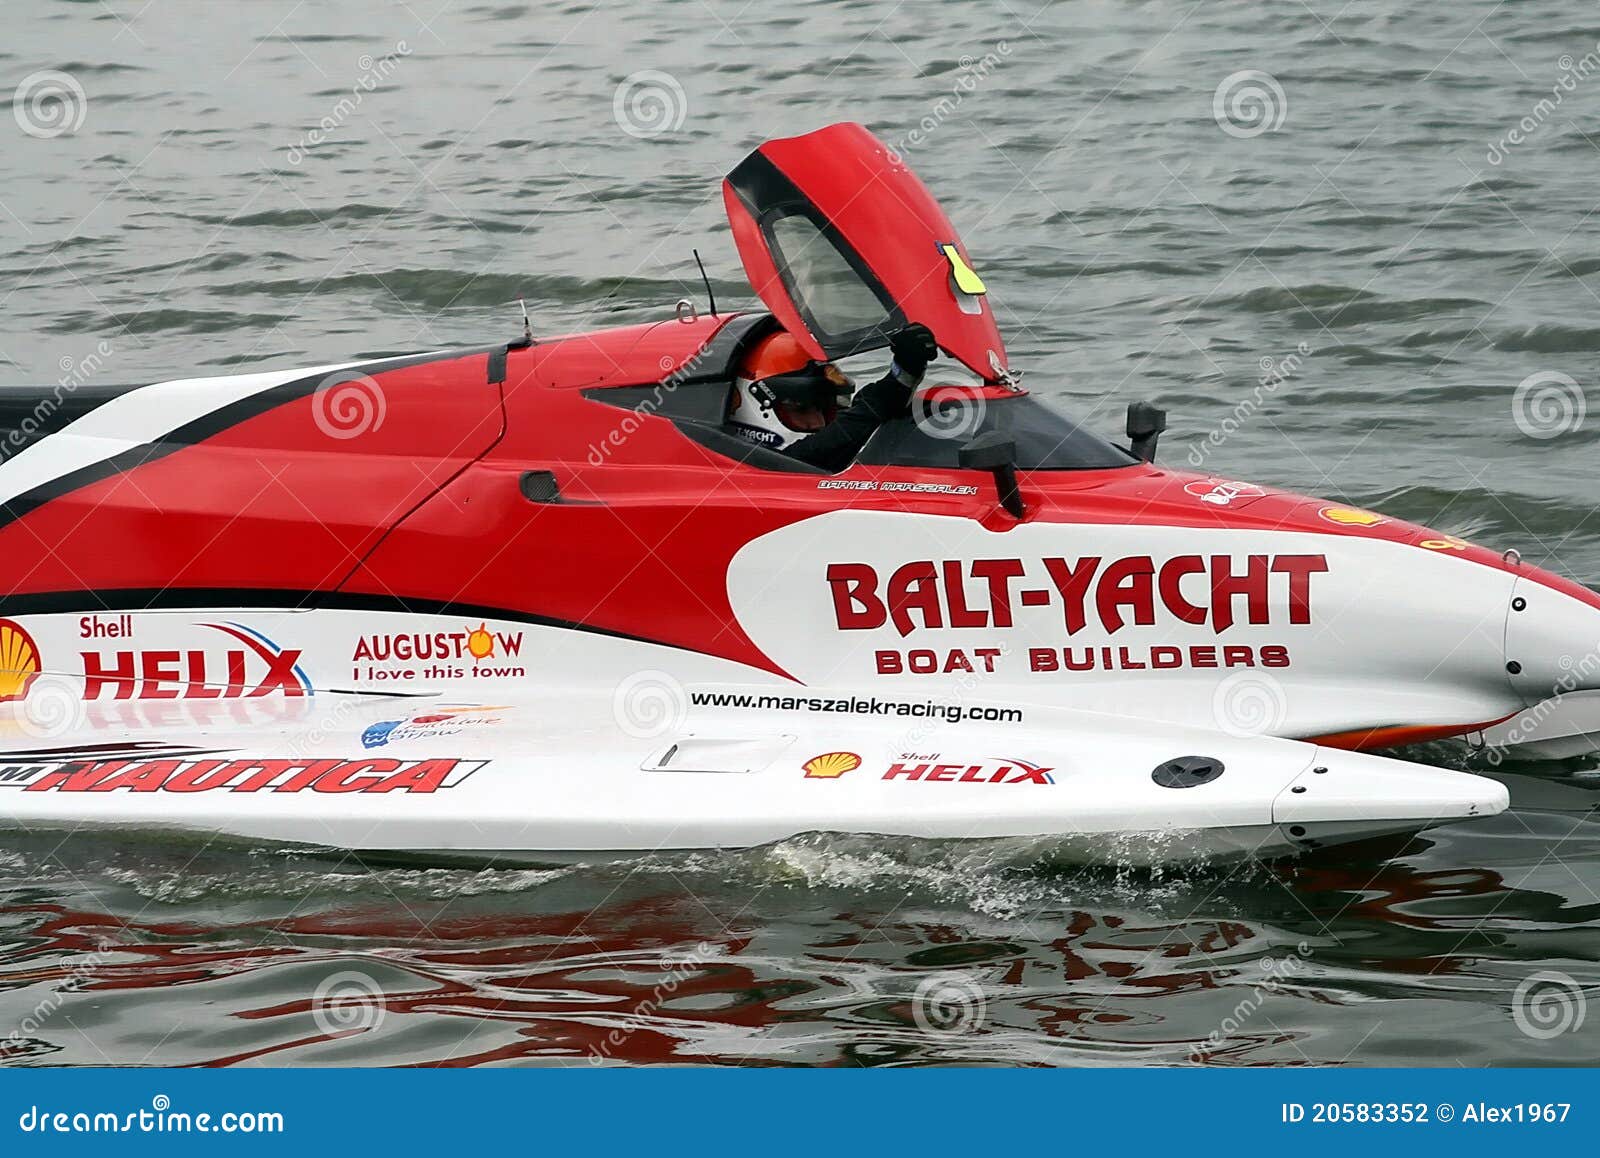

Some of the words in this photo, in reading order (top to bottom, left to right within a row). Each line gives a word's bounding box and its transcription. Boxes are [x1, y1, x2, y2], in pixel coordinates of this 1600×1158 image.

[817, 480, 879, 490] BARTEK
[880, 481, 978, 495] MARSZALEK
[826, 553, 1328, 638] BALT-YACHT
[80, 614, 132, 638] Shell
[80, 647, 305, 700] HELIX
[354, 668, 359, 681] I
[368, 667, 416, 680] love
[424, 665, 465, 679] this
[472, 666, 525, 678] town
[875, 648, 1001, 675] BOAT
[1029, 645, 1290, 672] BUILDERS
[691, 692, 1022, 723] www.marszalekracing.com
[898, 753, 941, 761] Shell
[22, 758, 462, 793] NAUTICA
[881, 760, 1056, 784] HELIX
